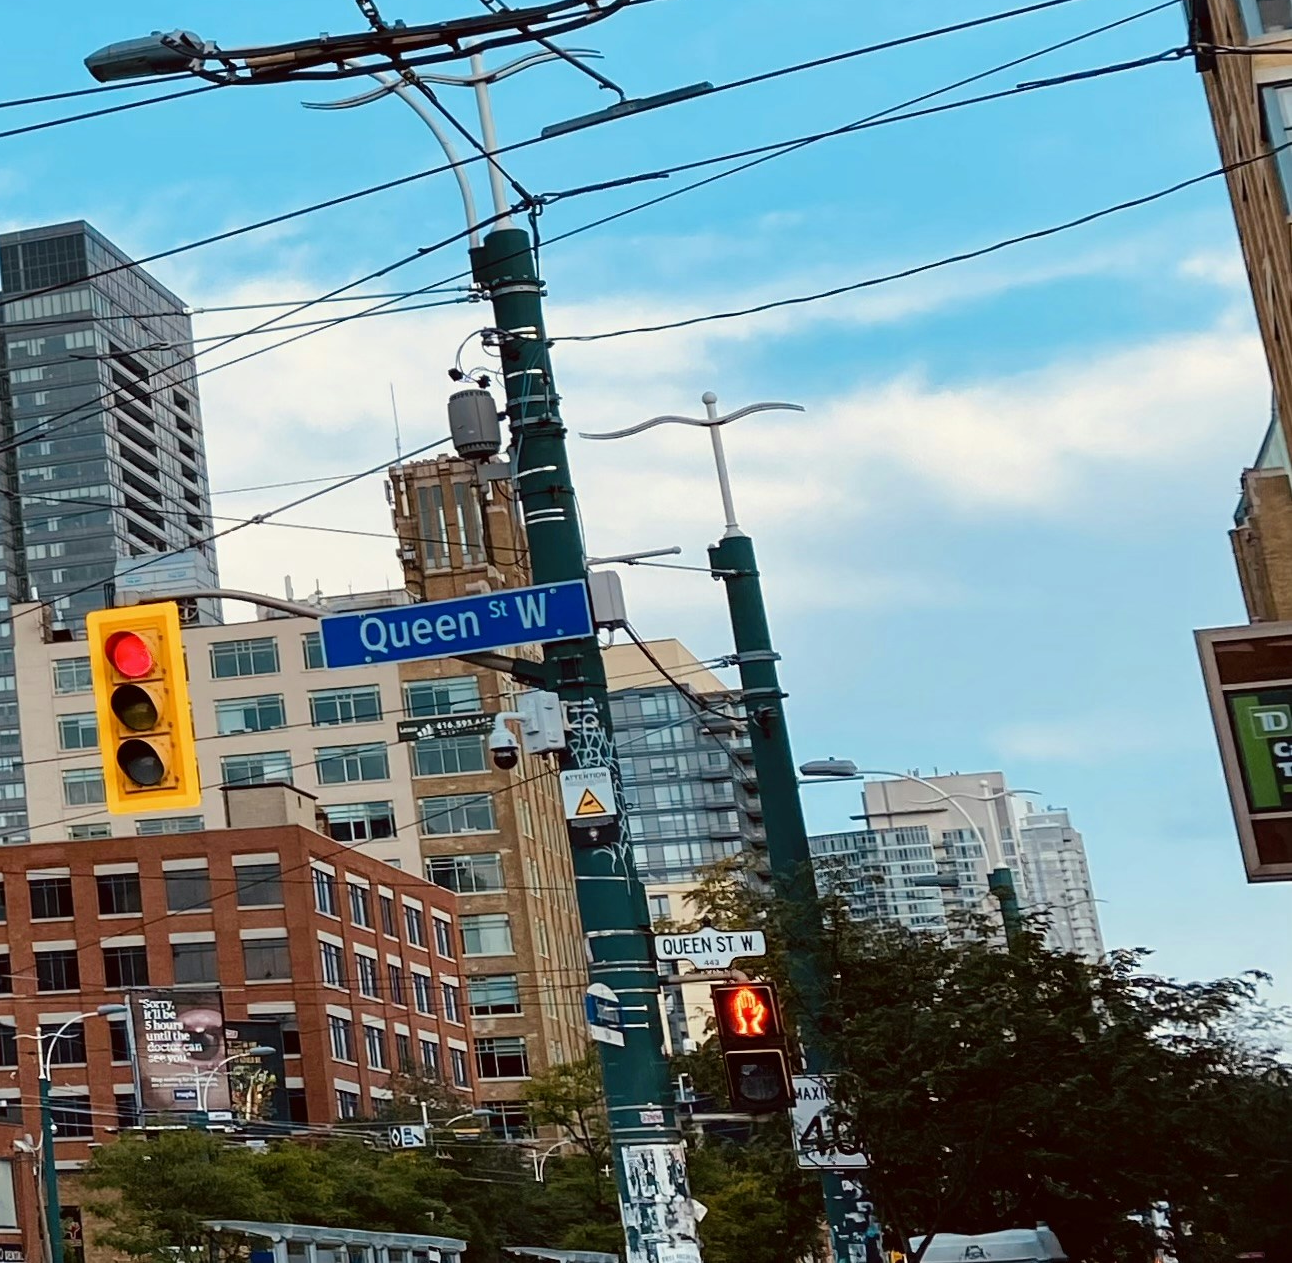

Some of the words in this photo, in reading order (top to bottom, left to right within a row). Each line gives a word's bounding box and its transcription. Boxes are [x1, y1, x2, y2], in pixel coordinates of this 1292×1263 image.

[360, 610, 480, 654] Queen
[488, 599, 508, 619] St
[514, 593, 546, 629] W
[1253, 711, 1288, 732] TD
[1273, 741, 1292, 757] C
[565, 771, 607, 782] ATTENTION
[663, 936, 712, 955] QUEEN
[162, 1009, 176, 1020] be
[145, 1020, 152, 1030] 5
[153, 1020, 184, 1030] hours
[146, 1031, 172, 1041] until
[173, 1030, 191, 1041] the
[147, 1042, 182, 1053] doctor
[183, 1043, 203, 1052] can
[148, 1053, 166, 1064] see
[796, 1087, 824, 1100] MAXI
